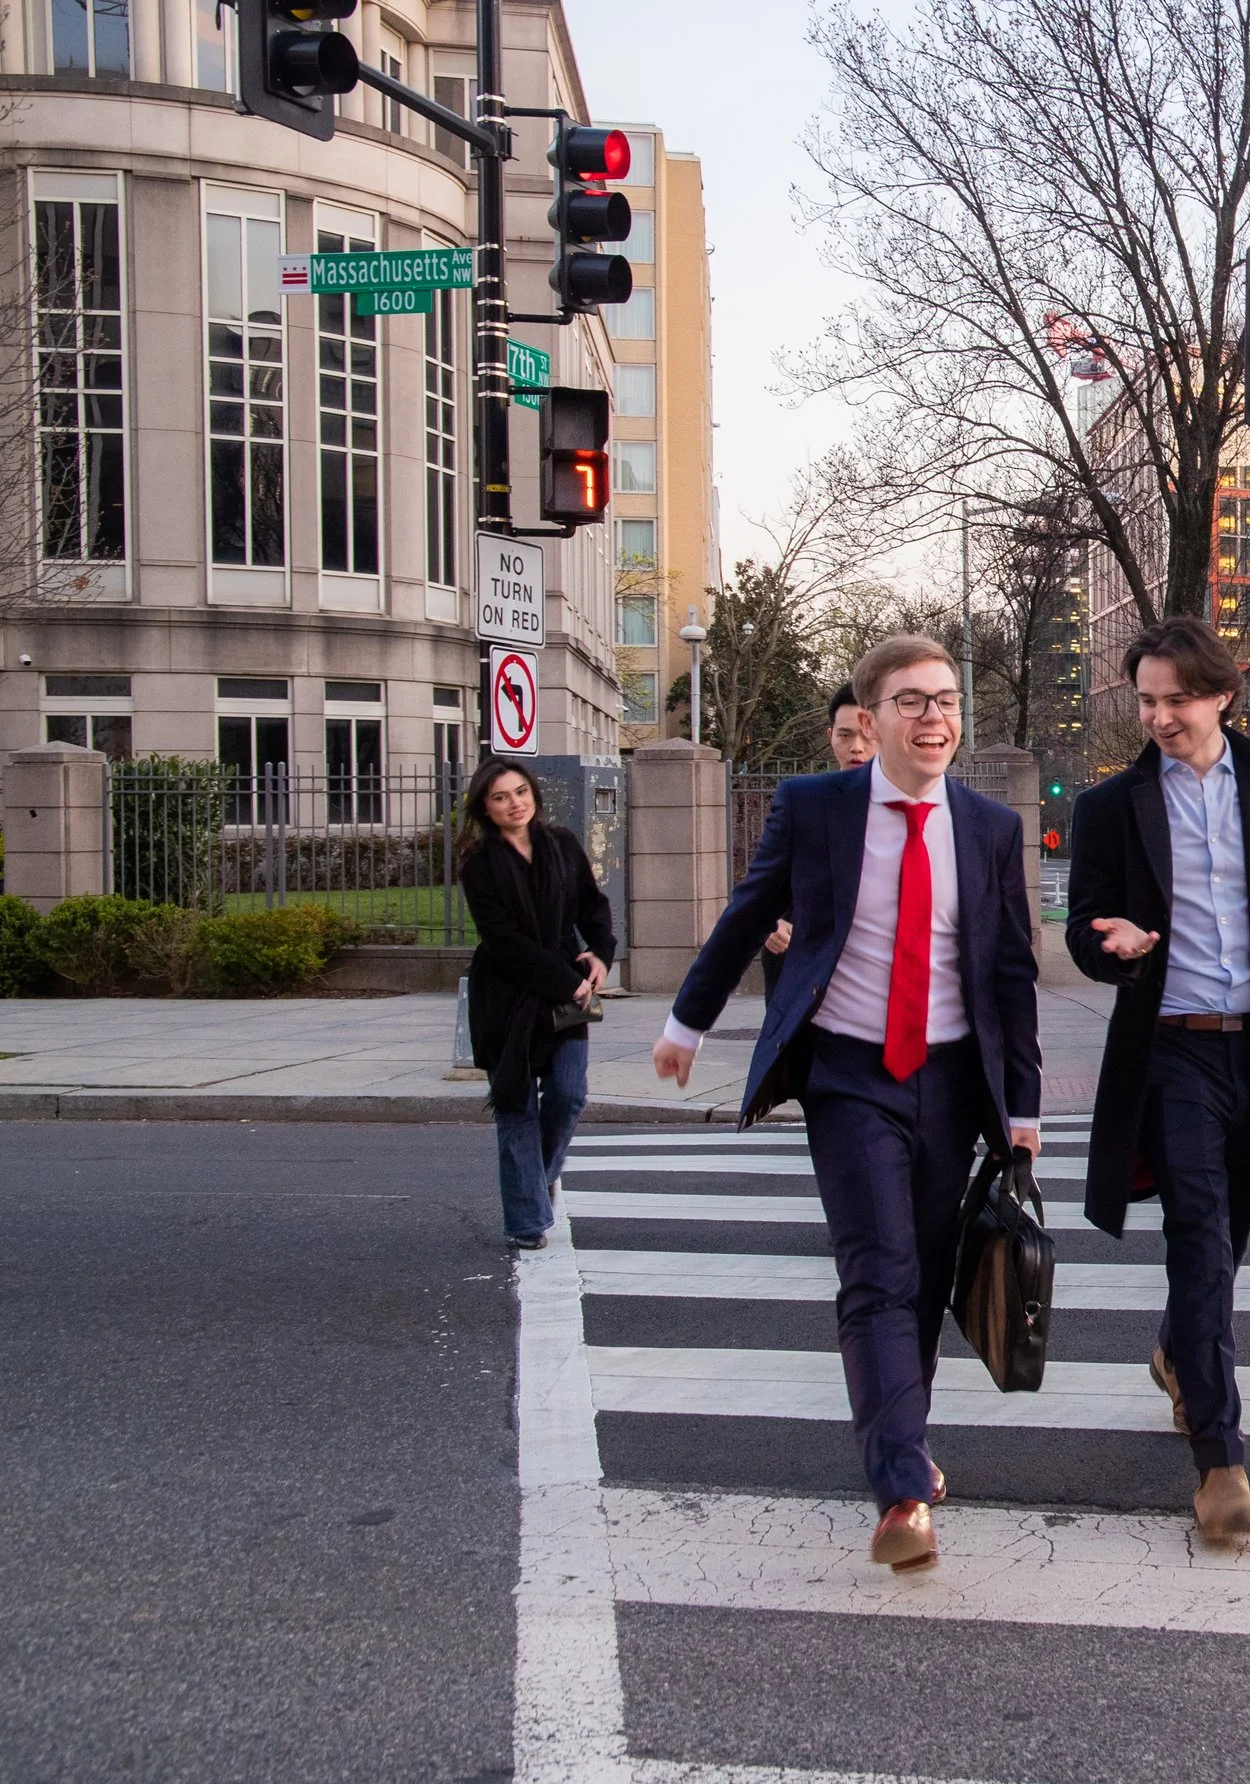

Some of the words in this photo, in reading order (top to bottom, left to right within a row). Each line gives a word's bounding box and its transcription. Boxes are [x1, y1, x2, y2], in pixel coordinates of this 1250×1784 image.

[312, 253, 448, 285] Massachusetts
[452, 251, 473, 265] Ave
[453, 268, 472, 283] NW
[373, 291, 415, 311] 1600
[575, 465, 595, 508] 7
[500, 553, 524, 576] NO
[491, 577, 533, 604] TURN
[483, 604, 503, 626] ON
[512, 609, 540, 632] RED
